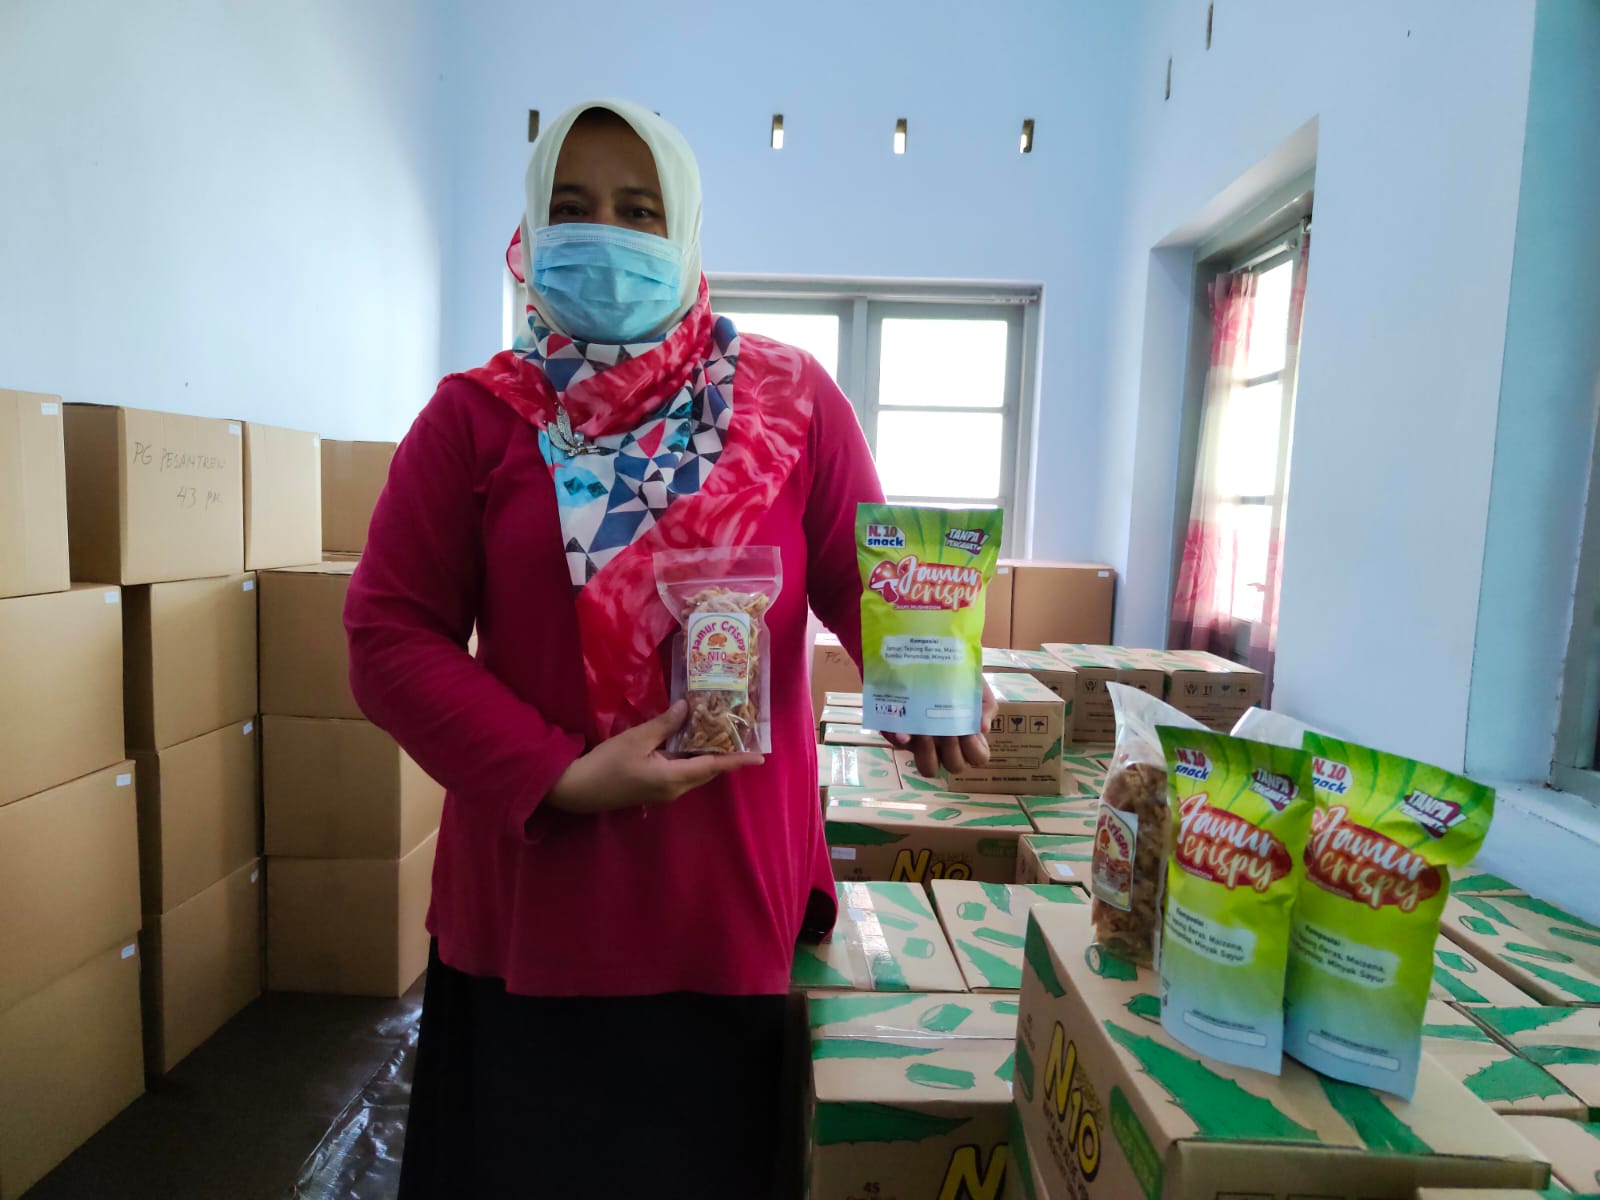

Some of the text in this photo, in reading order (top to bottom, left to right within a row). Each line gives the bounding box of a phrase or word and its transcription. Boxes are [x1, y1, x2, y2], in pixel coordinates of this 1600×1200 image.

[867, 537, 904, 547] snack
[896, 555, 980, 594] Jamur
[911, 580, 978, 610] crispy
[692, 621, 717, 650] Jamur
[1175, 764, 1208, 780] snack
[1327, 762, 1347, 780] 10
[1177, 793, 1276, 857] Jamur
[1312, 805, 1428, 880] Jamur
[1184, 835, 1273, 890] crispy
[1320, 852, 1420, 911] crispy
[1044, 1020, 1101, 1182] N10
